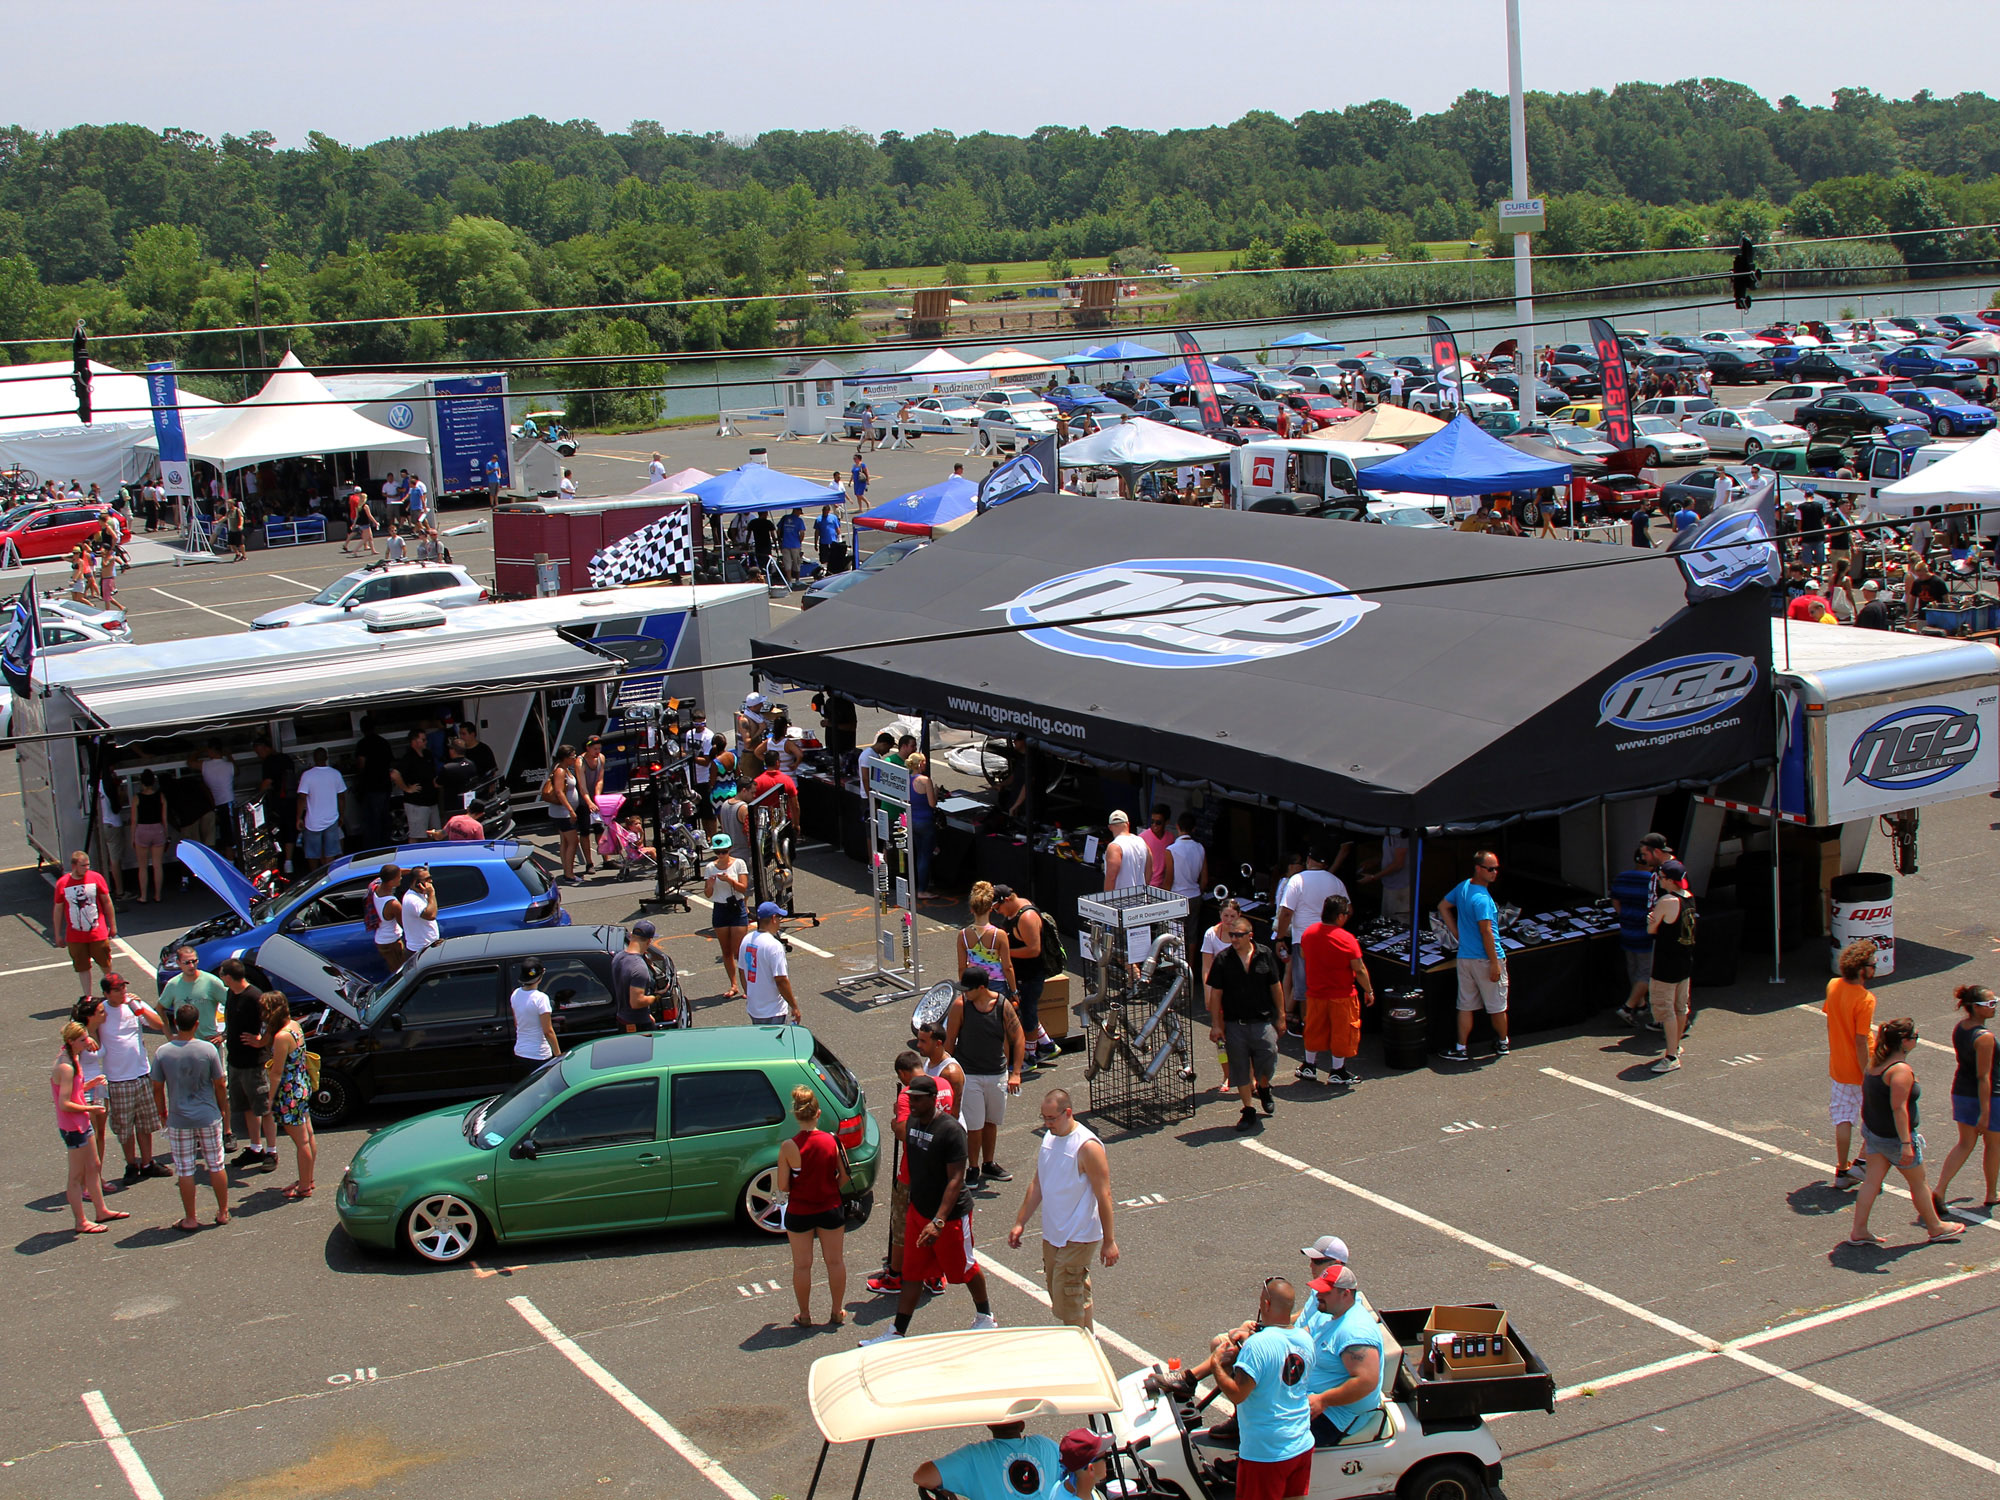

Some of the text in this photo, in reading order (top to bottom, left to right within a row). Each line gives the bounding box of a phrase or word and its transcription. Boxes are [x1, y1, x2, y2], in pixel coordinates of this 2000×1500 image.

[1504, 202, 1531, 211] CURE
[866, 384, 898, 394] Audizine
[938, 381, 991, 394] Audizine.com
[1595, 656, 1755, 728] NGP
[1646, 687, 1746, 718] RACING
[947, 695, 1086, 739] www.ngpracing.com
[1615, 716, 1741, 751] www.ngpracing.com
[1842, 713, 1979, 786] NGP
[1891, 755, 1956, 774] RACING
[1145, 909, 1169, 919] Downpipe
[1849, 905, 1892, 920] APR
